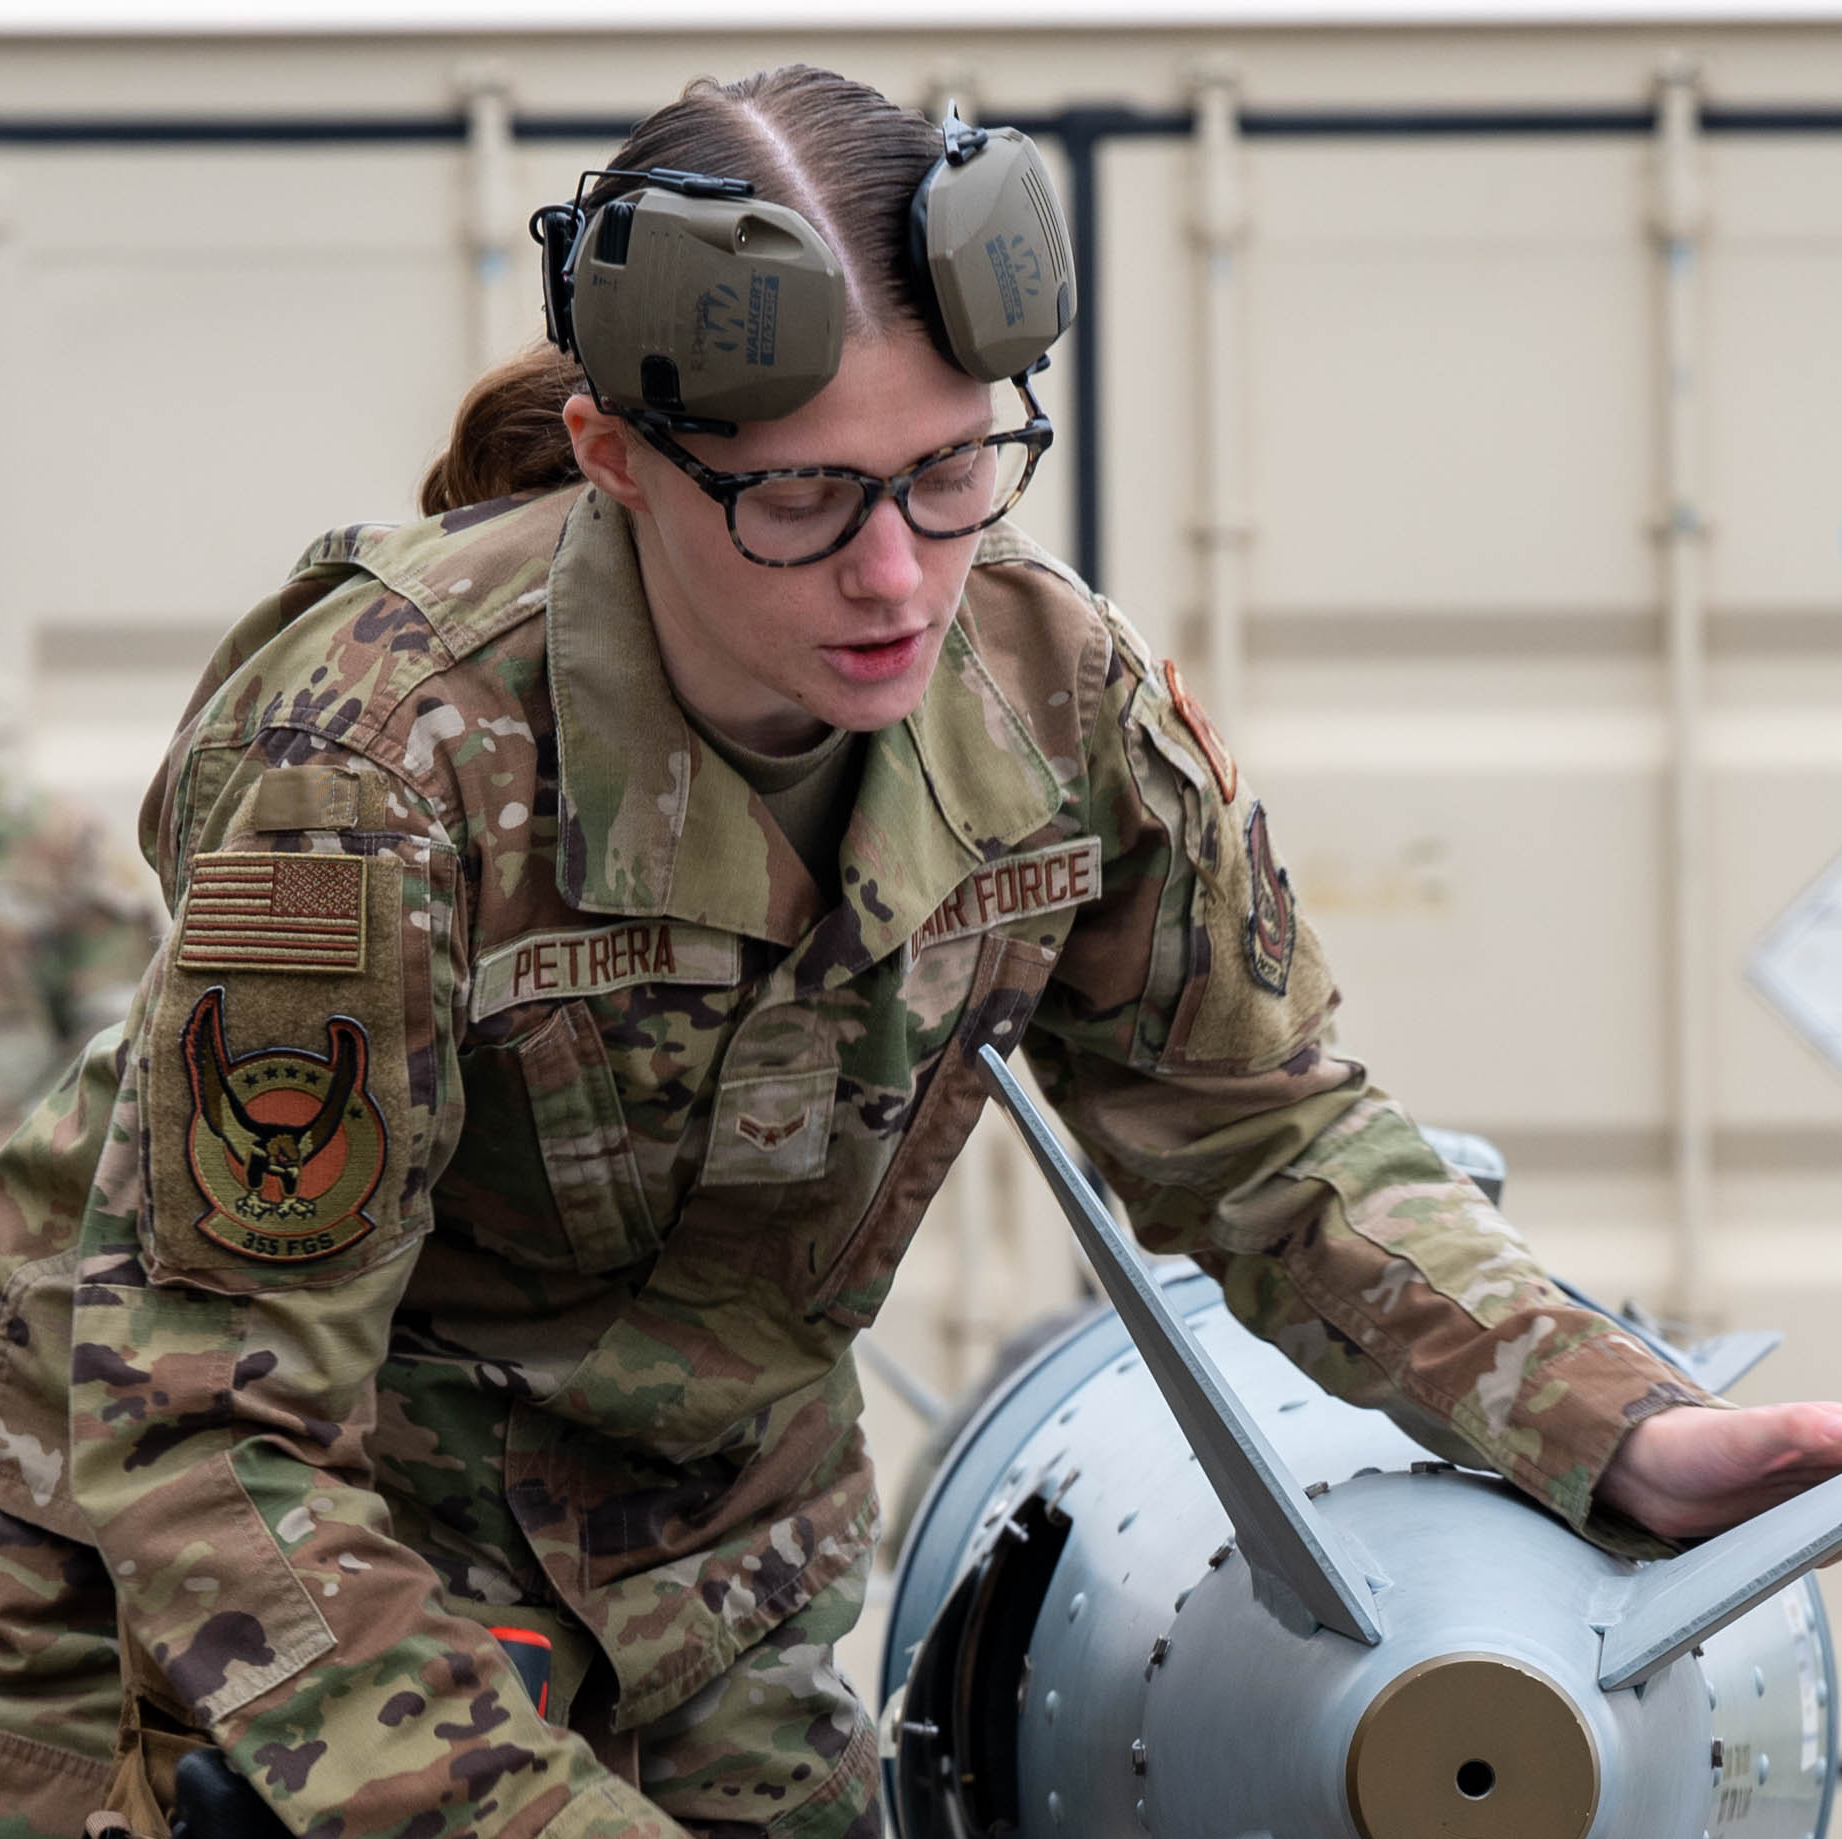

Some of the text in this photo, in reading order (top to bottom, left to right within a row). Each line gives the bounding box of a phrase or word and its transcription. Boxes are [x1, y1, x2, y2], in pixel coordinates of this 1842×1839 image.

[973, 850, 1090, 923] FORCE
[513, 925, 676, 998] PETRERA
[242, 1231, 334, 1256] 355 FGS
